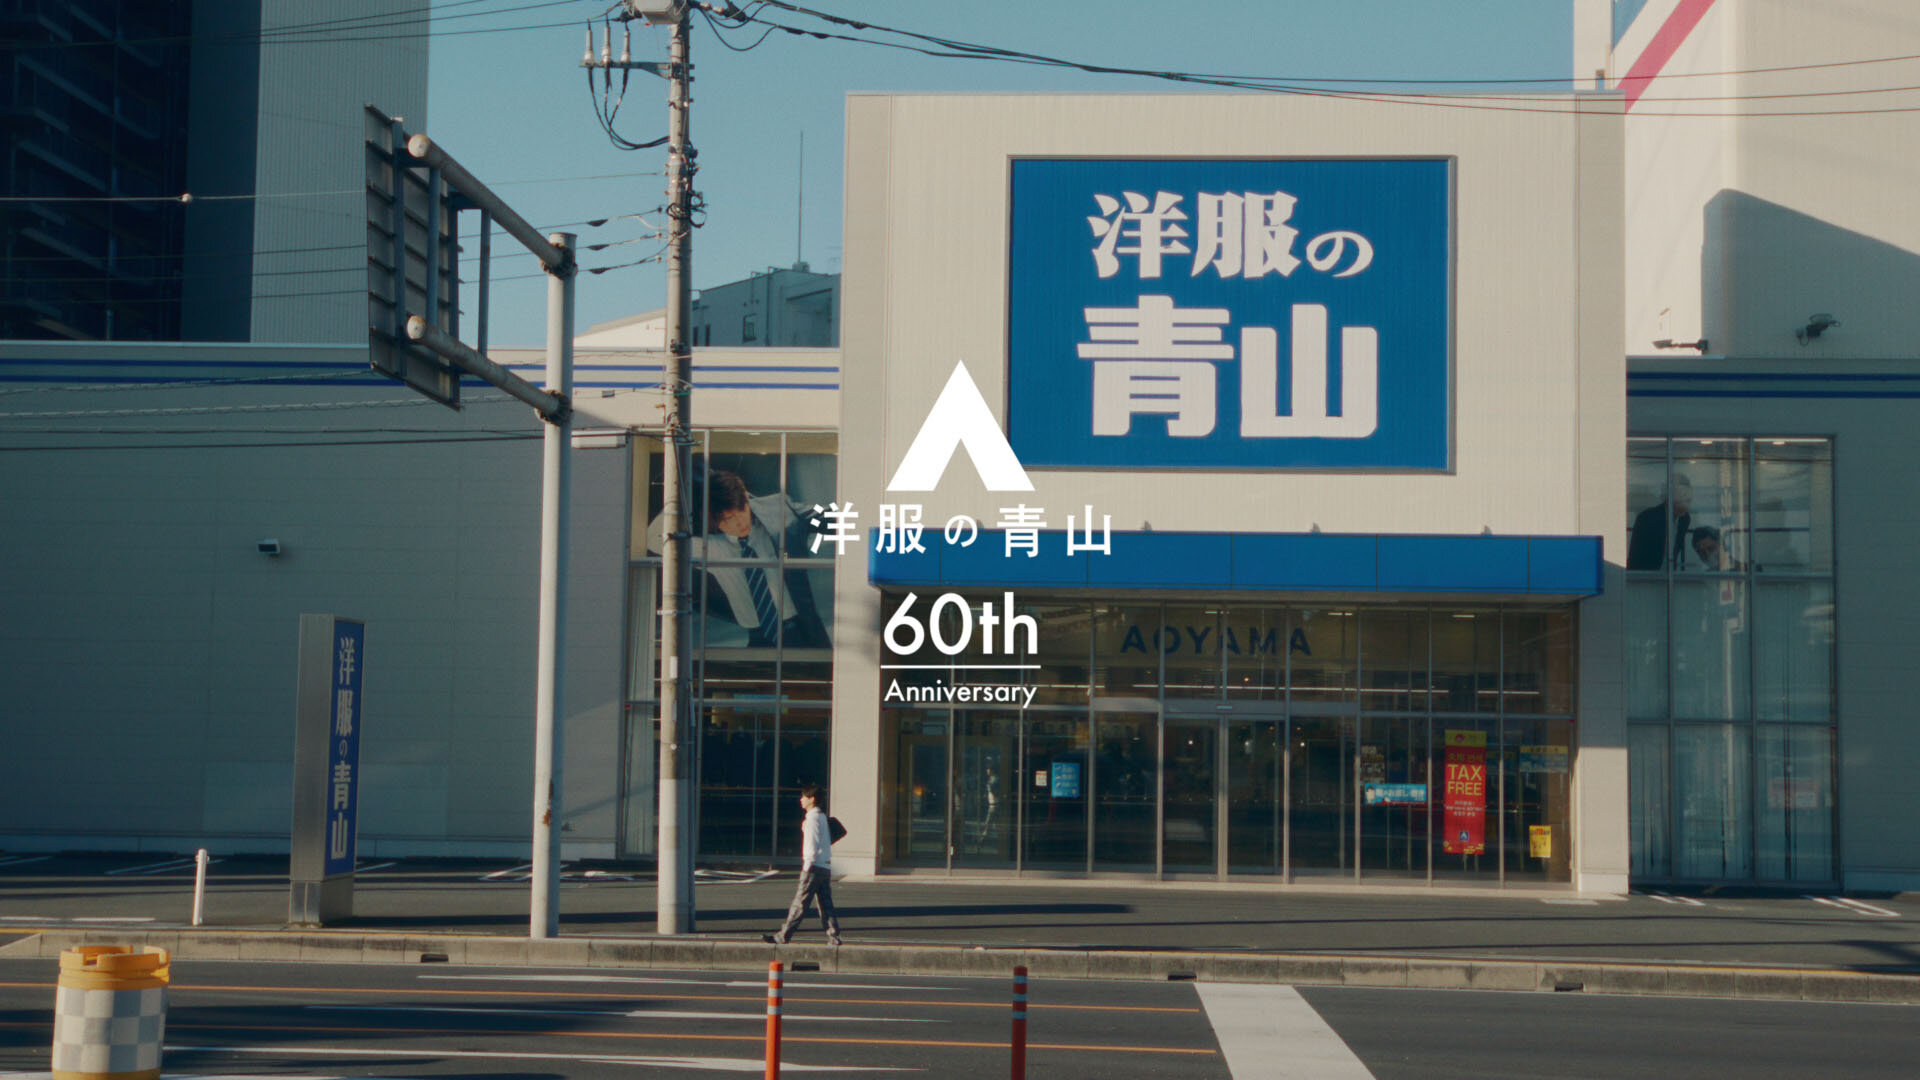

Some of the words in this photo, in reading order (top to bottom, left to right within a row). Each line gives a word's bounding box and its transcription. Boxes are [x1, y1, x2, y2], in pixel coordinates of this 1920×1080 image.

[1087, 190, 1375, 279] 洋服の
[1076, 294, 1379, 438] 青山
[1120, 625, 1312, 656] AOYAMA
[331, 637, 355, 860] 洋服の青山
[1447, 763, 1483, 781] TAX
[1447, 780, 1483, 796] FREE
